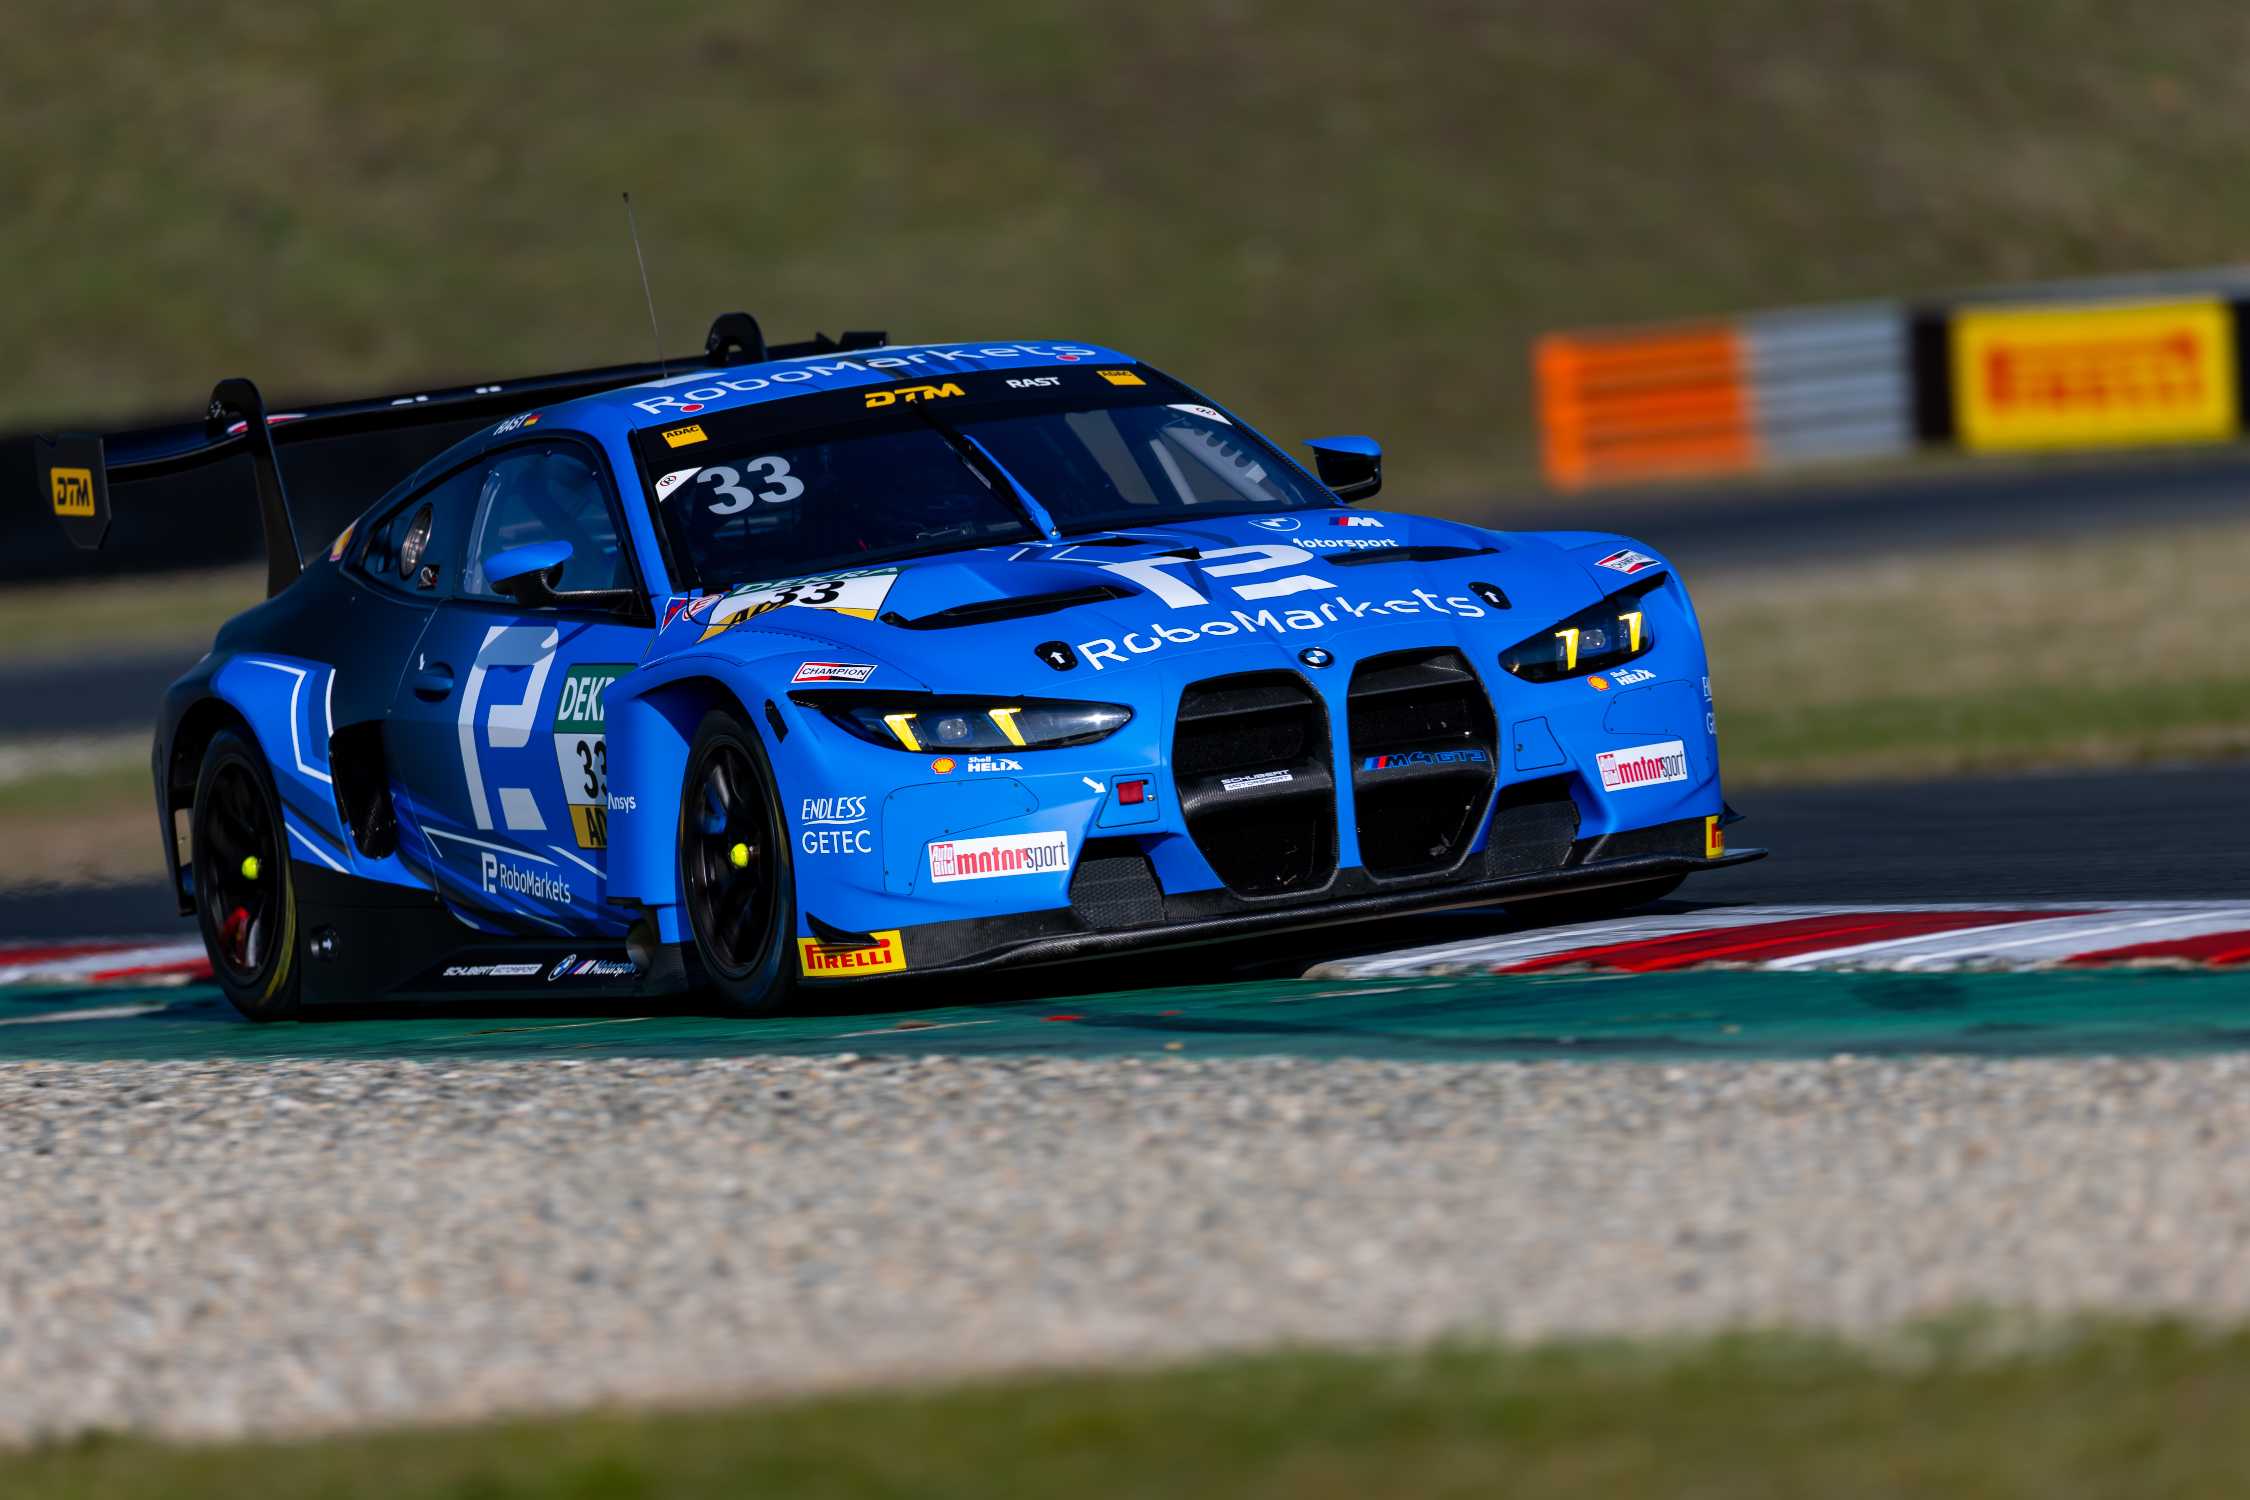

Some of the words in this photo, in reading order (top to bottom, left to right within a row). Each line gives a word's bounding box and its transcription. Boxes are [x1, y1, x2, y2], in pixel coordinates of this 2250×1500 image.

[632, 344, 1097, 414] RoboMarkets
[1006, 376, 1061, 389] RAST
[864, 383, 966, 408] DTM
[666, 425, 700, 438] ADAC
[57, 476, 91, 507] DTM
[697, 456, 805, 515] 33
[769, 580, 845, 605] 33
[1077, 587, 1486, 671] RoboMarkets
[802, 667, 868, 677] CHAMPION
[557, 676, 616, 721] DEK
[967, 758, 1024, 773] HELIX
[608, 791, 637, 814] Ansys
[801, 796, 867, 820] ENDLESS
[802, 829, 872, 854] GETEC
[499, 863, 571, 905] RoboMarkets
[805, 938, 893, 970] PIRELLI
